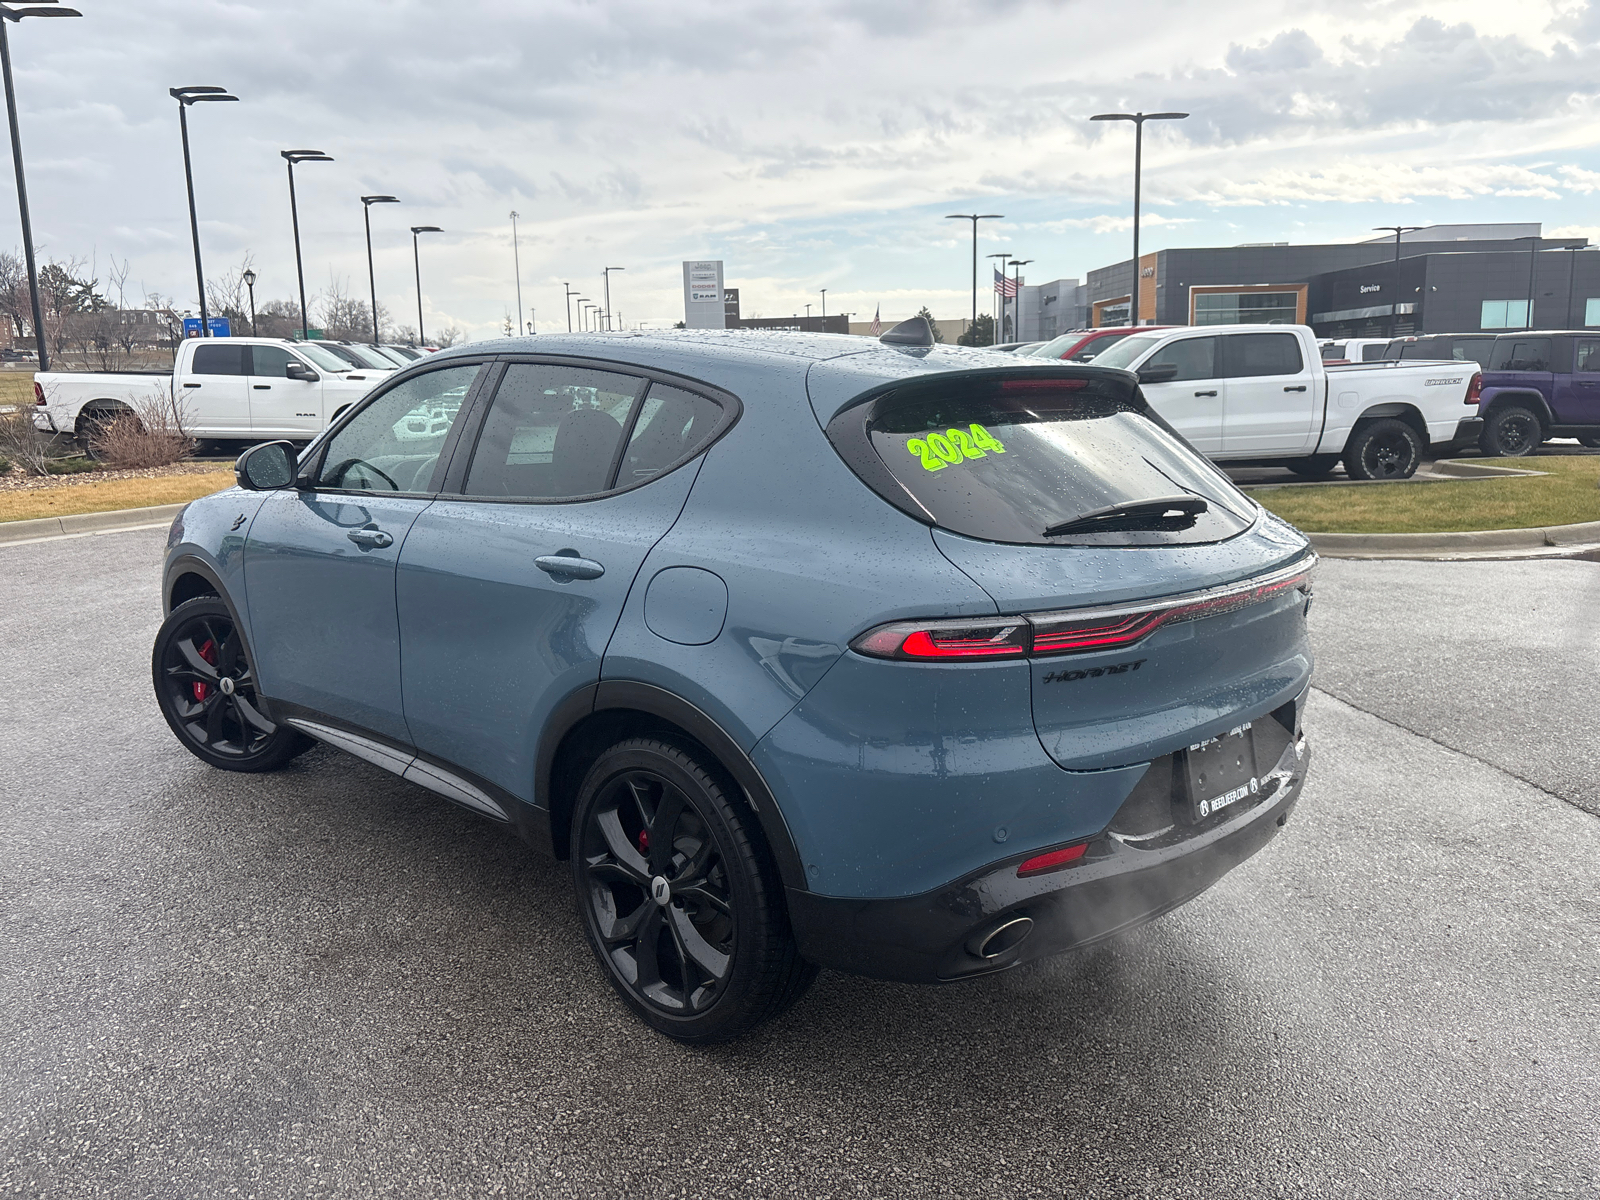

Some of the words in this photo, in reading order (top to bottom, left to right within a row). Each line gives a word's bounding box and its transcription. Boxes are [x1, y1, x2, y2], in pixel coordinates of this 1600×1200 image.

[694, 262, 712, 270] Jeep
[1360, 284, 1381, 294] Service
[1424, 378, 1463, 386] WARLOCK
[906, 423, 1007, 472] 2024
[1042, 659, 1147, 684] HORNET
[1211, 785, 1249, 812] REEDJEEP.COM
